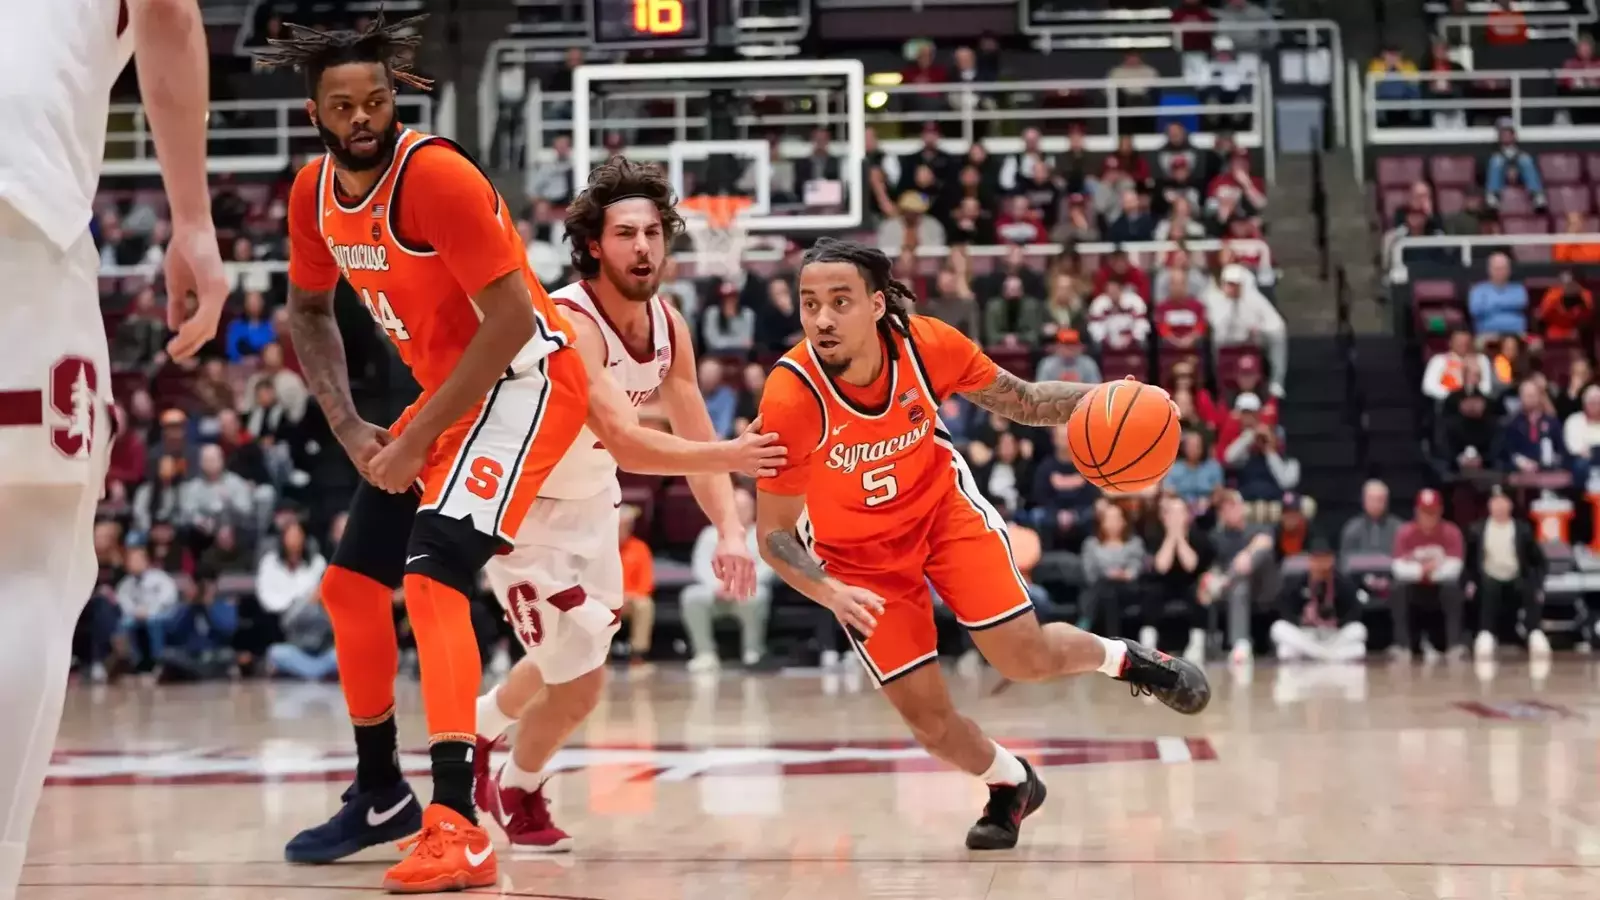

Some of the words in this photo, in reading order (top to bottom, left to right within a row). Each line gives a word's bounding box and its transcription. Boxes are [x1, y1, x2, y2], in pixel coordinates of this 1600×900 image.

[825, 418, 930, 474] Syracuse
[465, 456, 504, 500] S
[861, 463, 898, 507] 5
